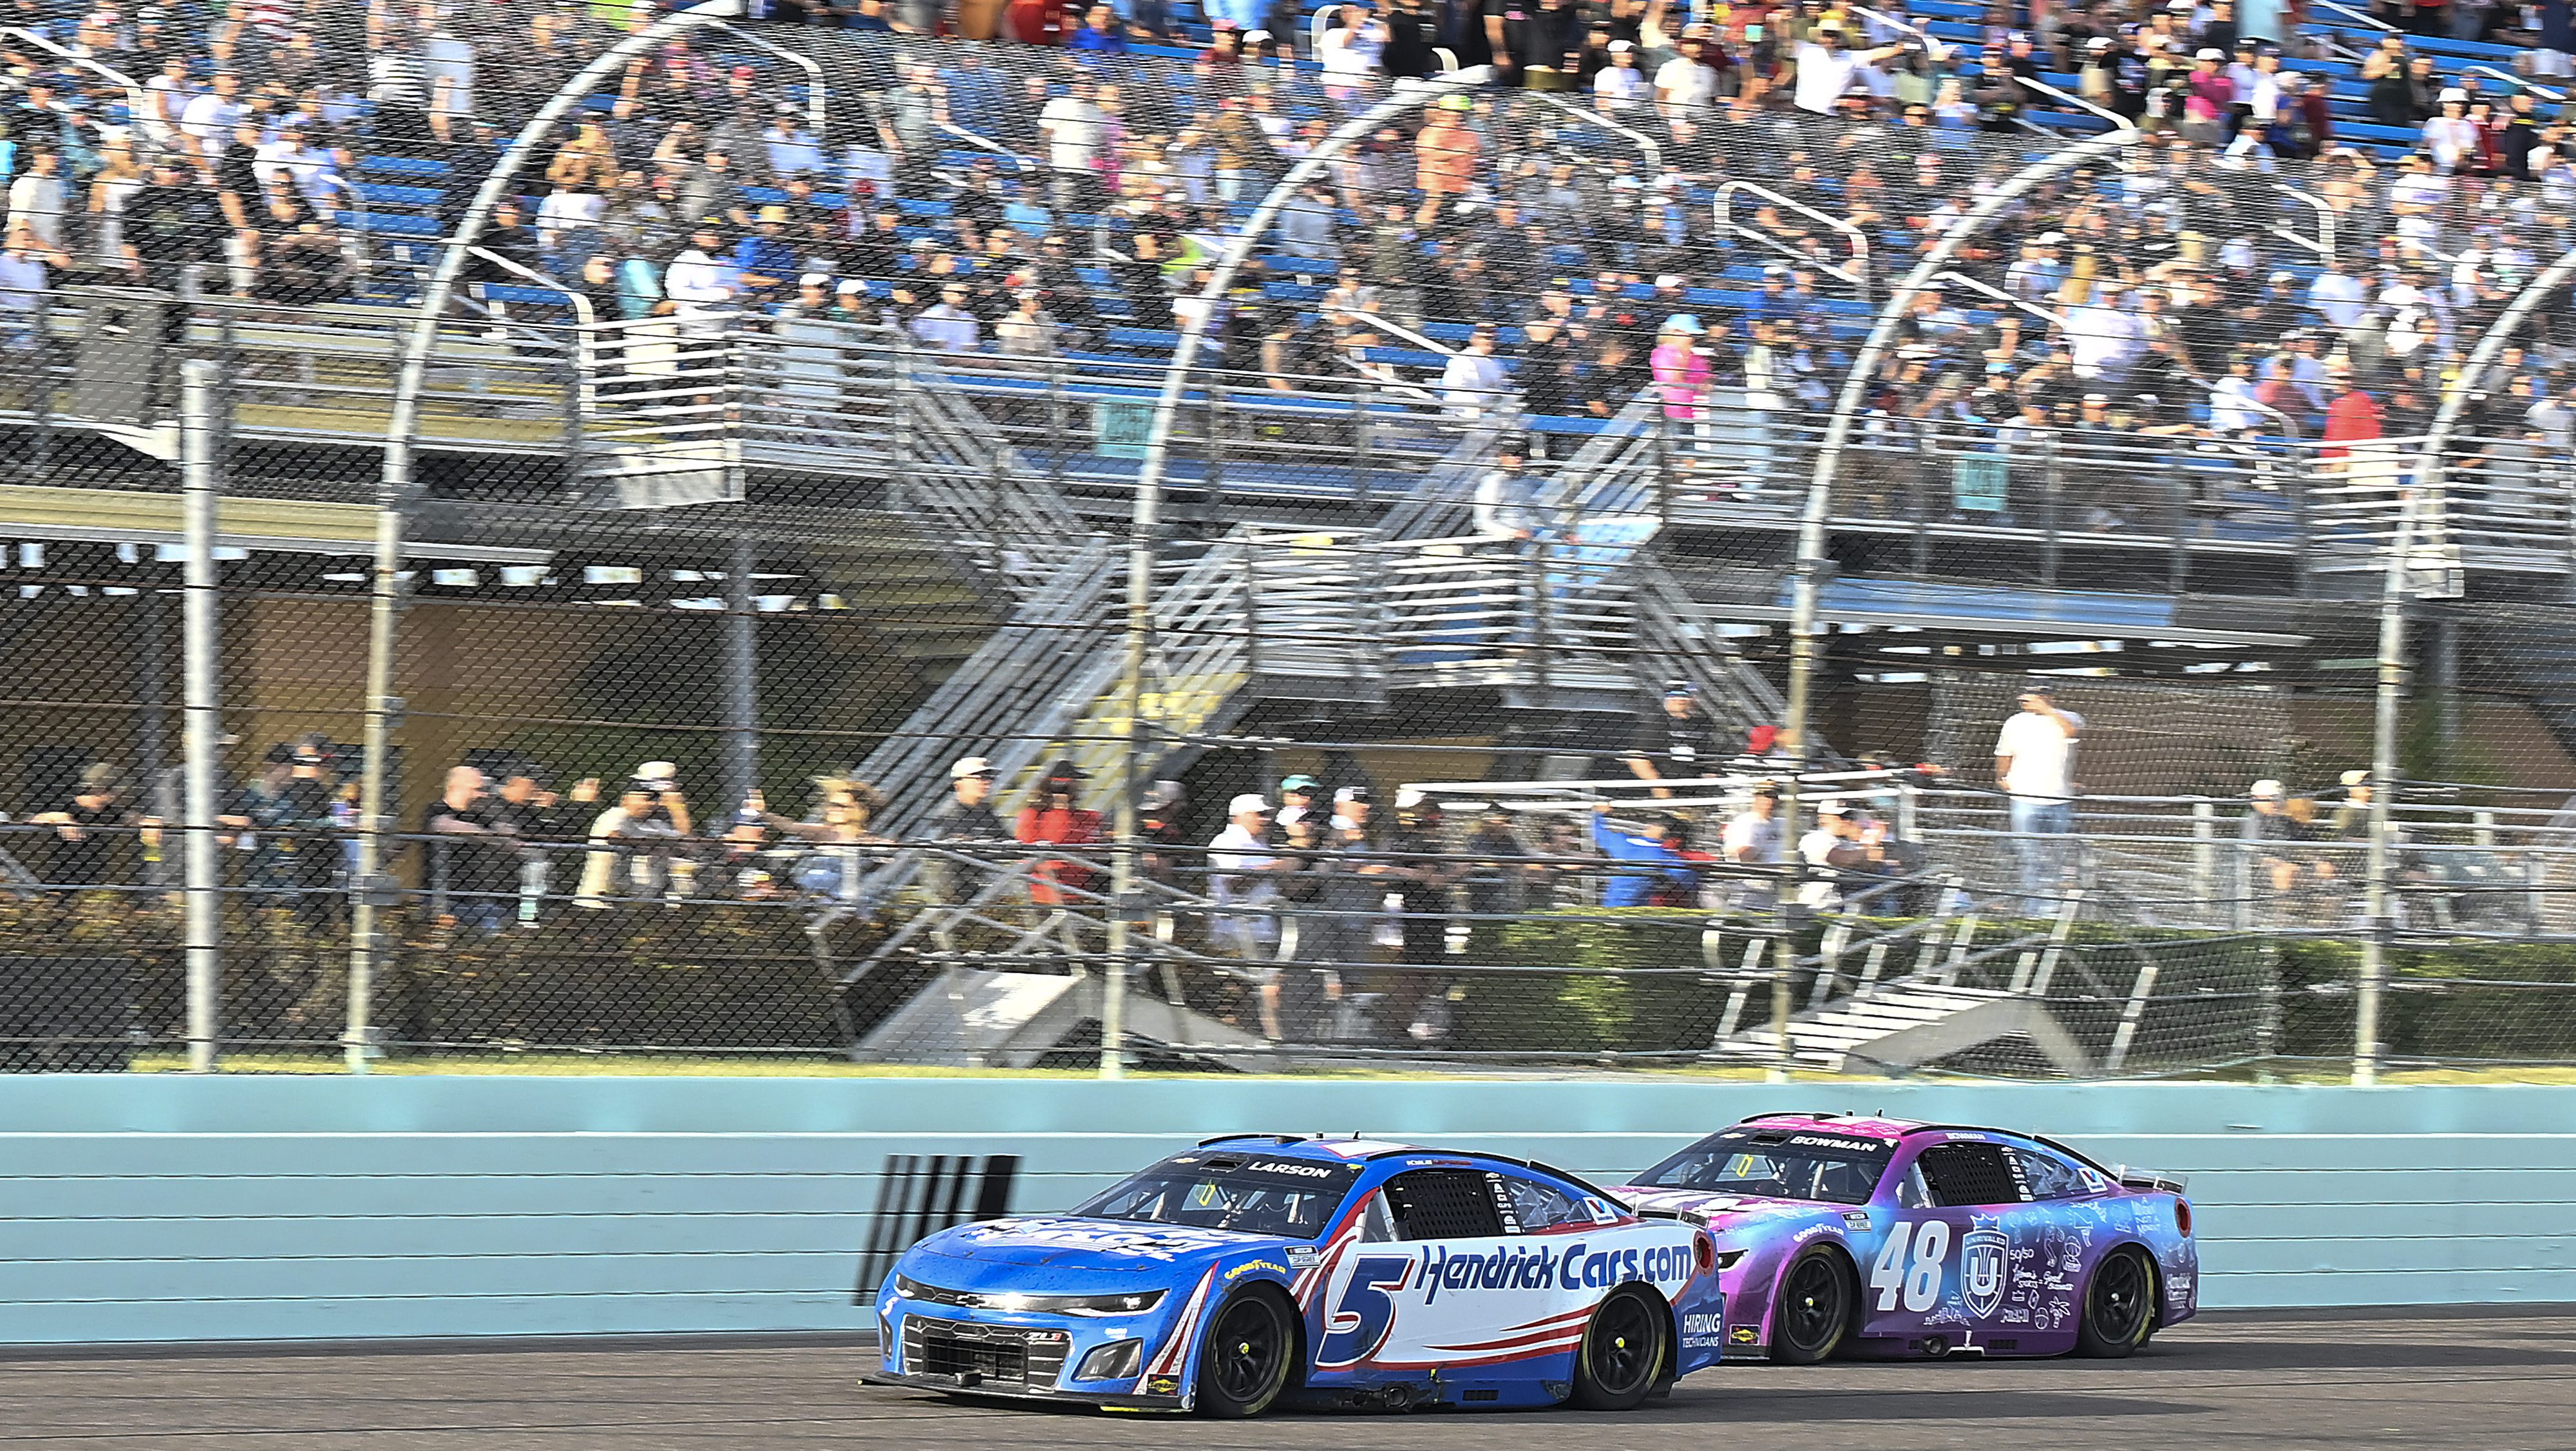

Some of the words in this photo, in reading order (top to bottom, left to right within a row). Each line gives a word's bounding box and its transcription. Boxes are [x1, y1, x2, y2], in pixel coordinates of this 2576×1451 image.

[1789, 1135, 1877, 1152] BOWMAN
[1247, 1161, 1332, 1178] LARSON
[1793, 1223, 1844, 1242] GOODYEAR
[1224, 1260, 1287, 1280] GOODYEAR
[1414, 1243, 1692, 1305] HendrickCars.com
[1870, 1220, 1949, 1311] 48
[1315, 1253, 1412, 1367] 5
[1683, 1313, 1721, 1334] HIRING
[1682, 1336, 1719, 1349] TECHNICIANS
